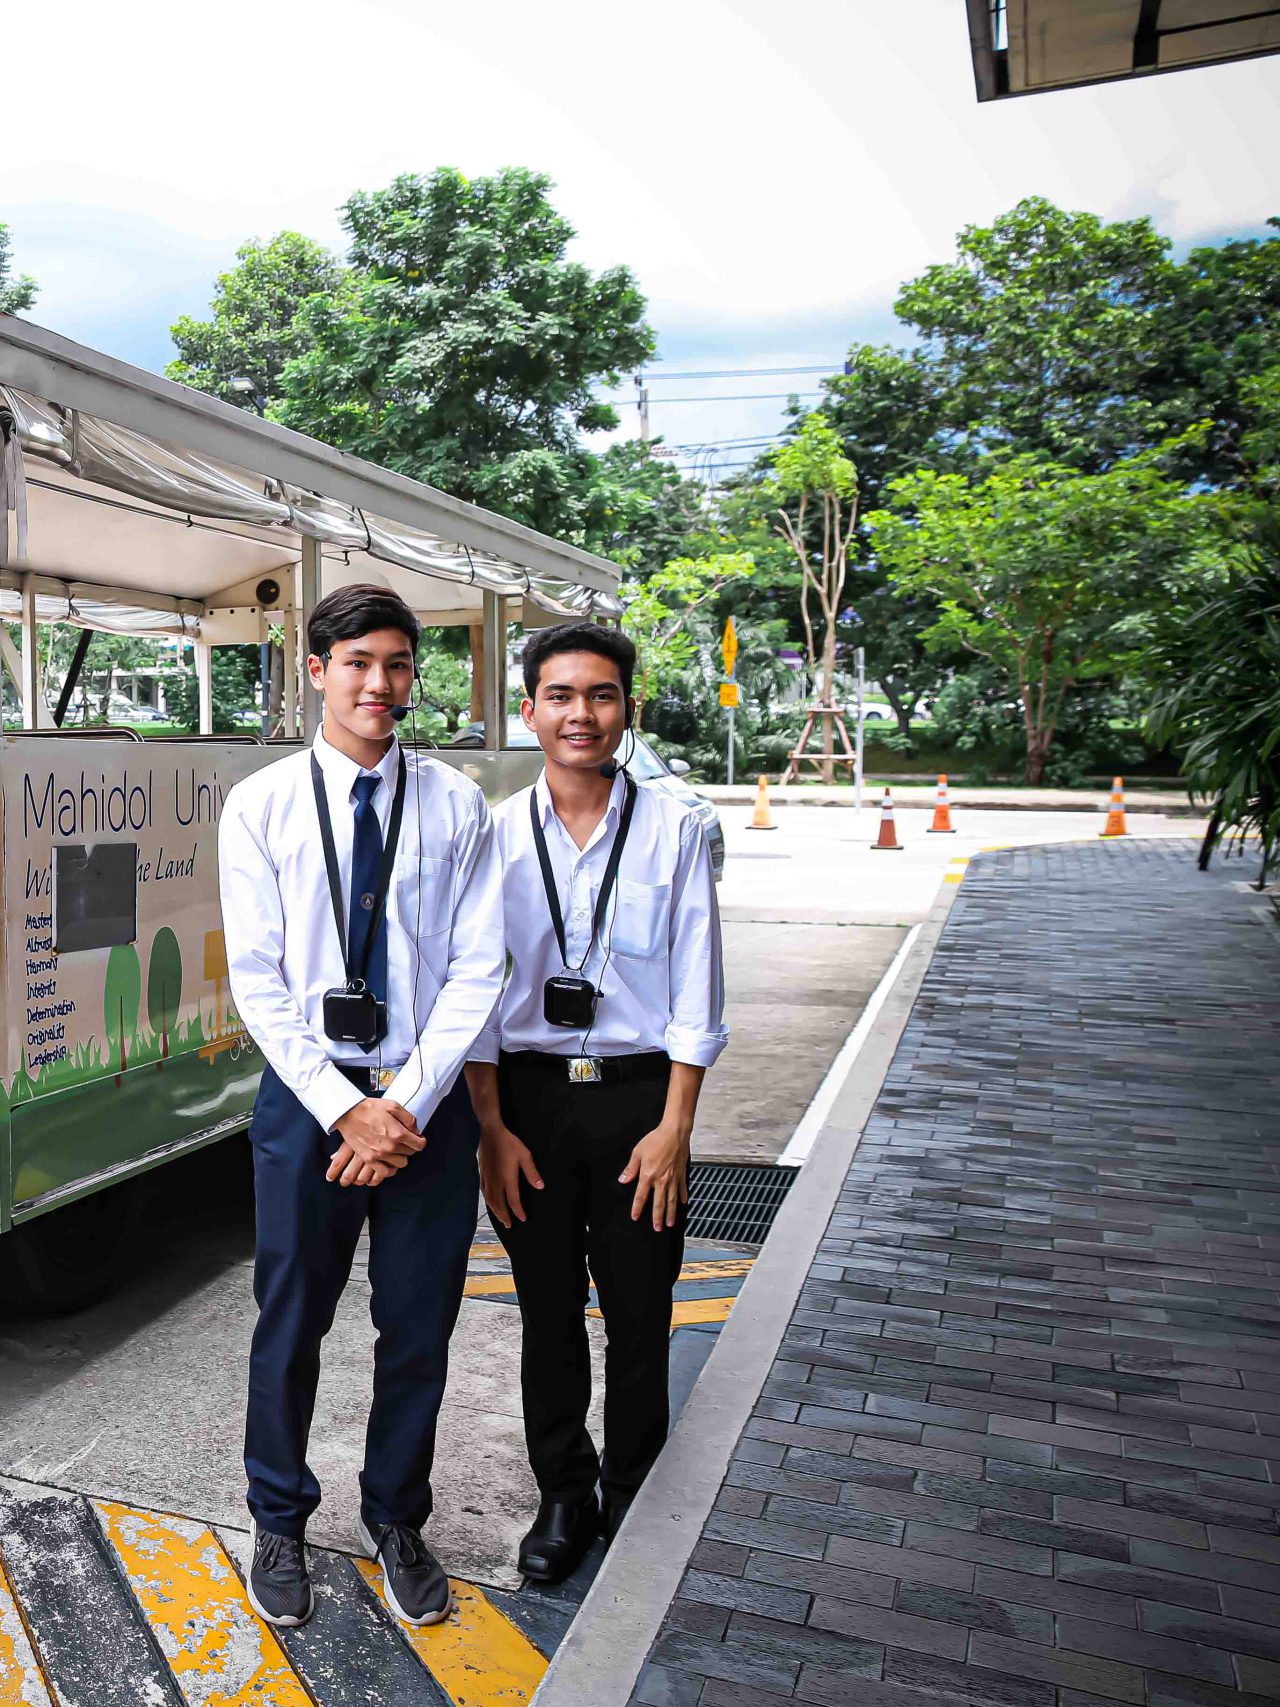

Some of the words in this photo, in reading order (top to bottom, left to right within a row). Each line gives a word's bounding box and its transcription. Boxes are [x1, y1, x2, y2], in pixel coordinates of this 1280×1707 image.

[23, 769, 153, 839] Mahidol
[155, 842, 198, 881] Land
[26, 978, 57, 1001] Integrity
[26, 999, 76, 1025] Determination
[27, 1043, 67, 1069] Leadership
